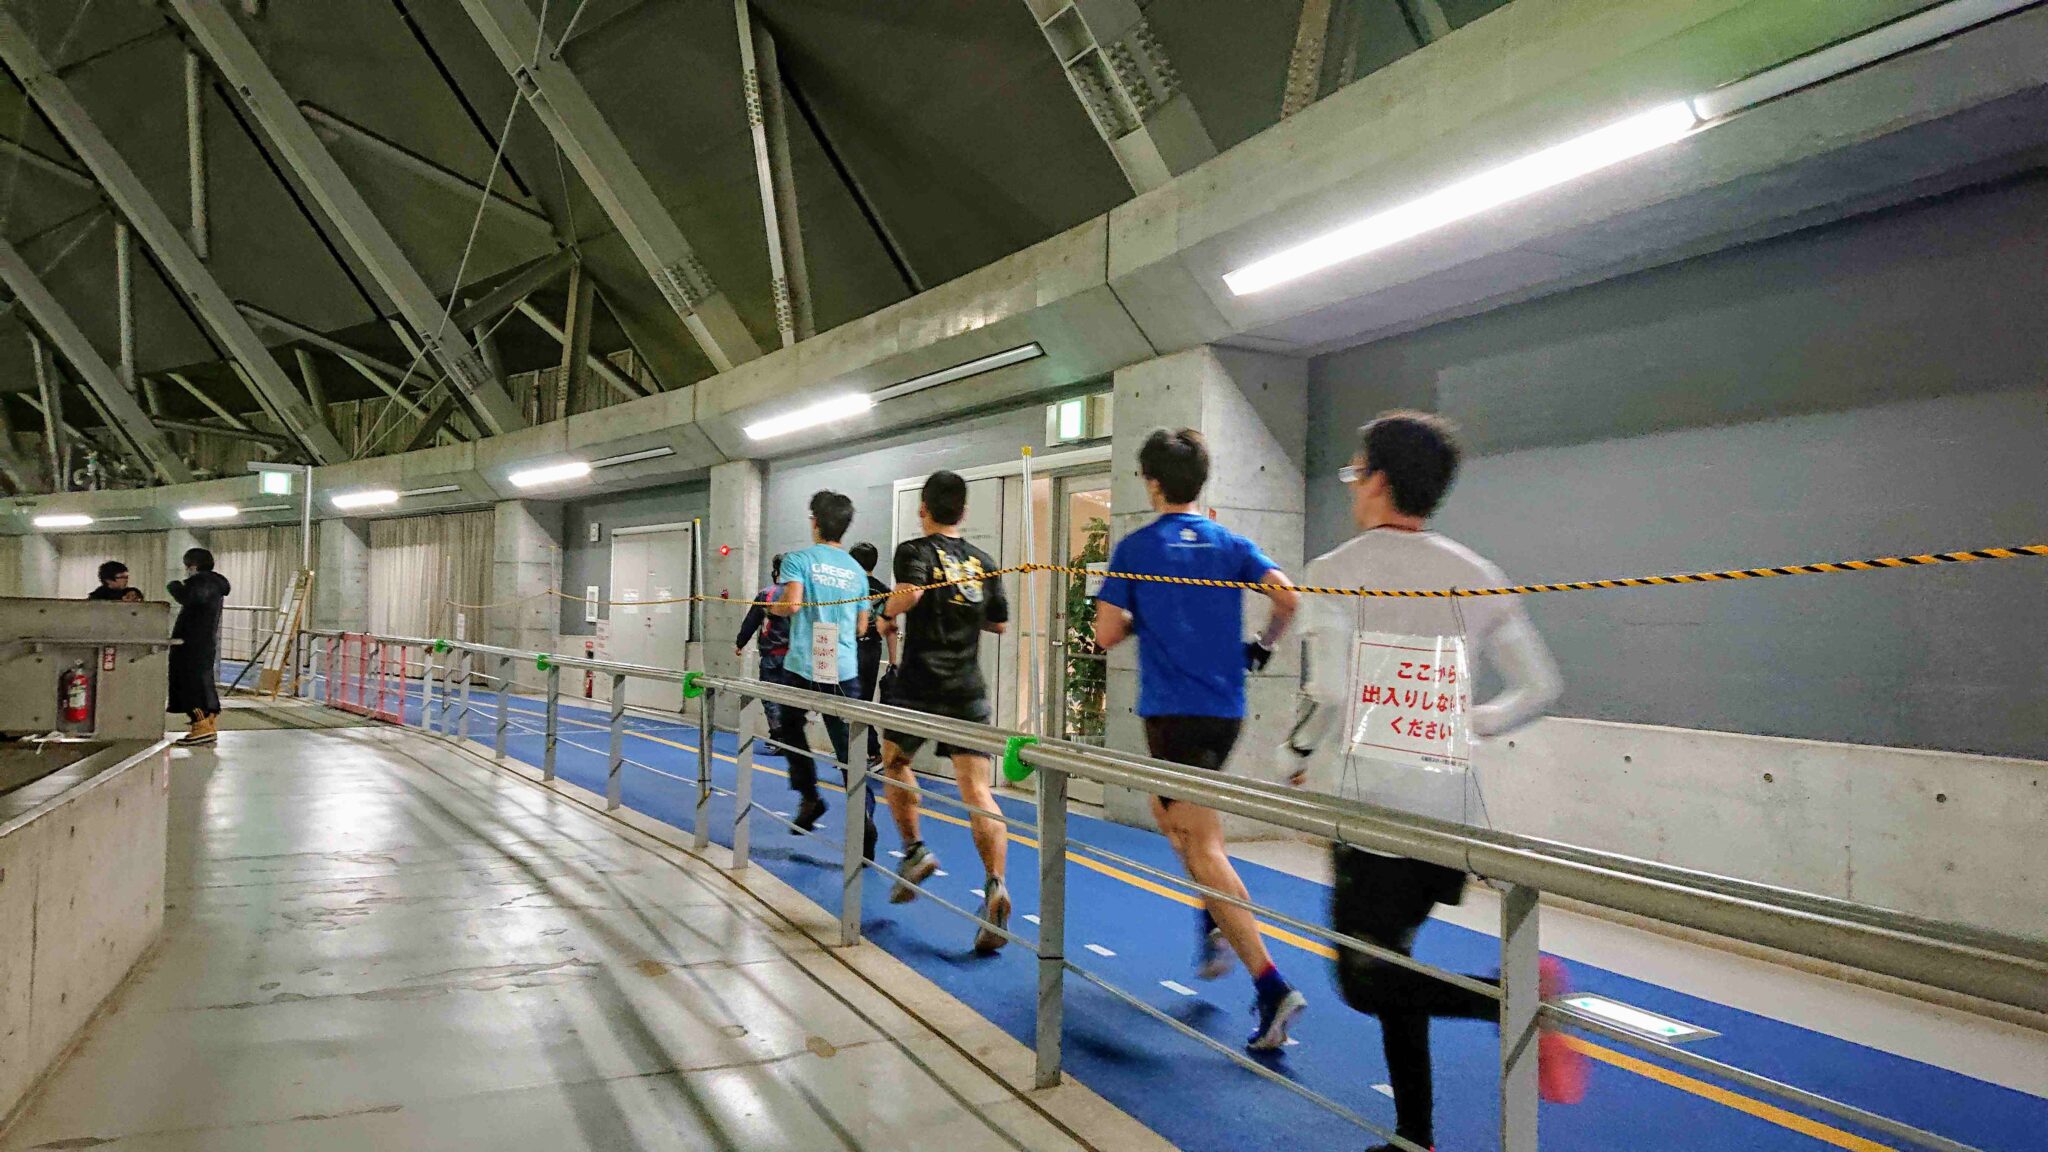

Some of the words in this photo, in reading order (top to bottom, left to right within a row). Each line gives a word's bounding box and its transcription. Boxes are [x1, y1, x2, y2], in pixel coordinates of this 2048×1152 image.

[812, 574, 859, 592] PROJE
[1397, 662, 1456, 684] ここから
[1390, 716, 1452, 740] ください
